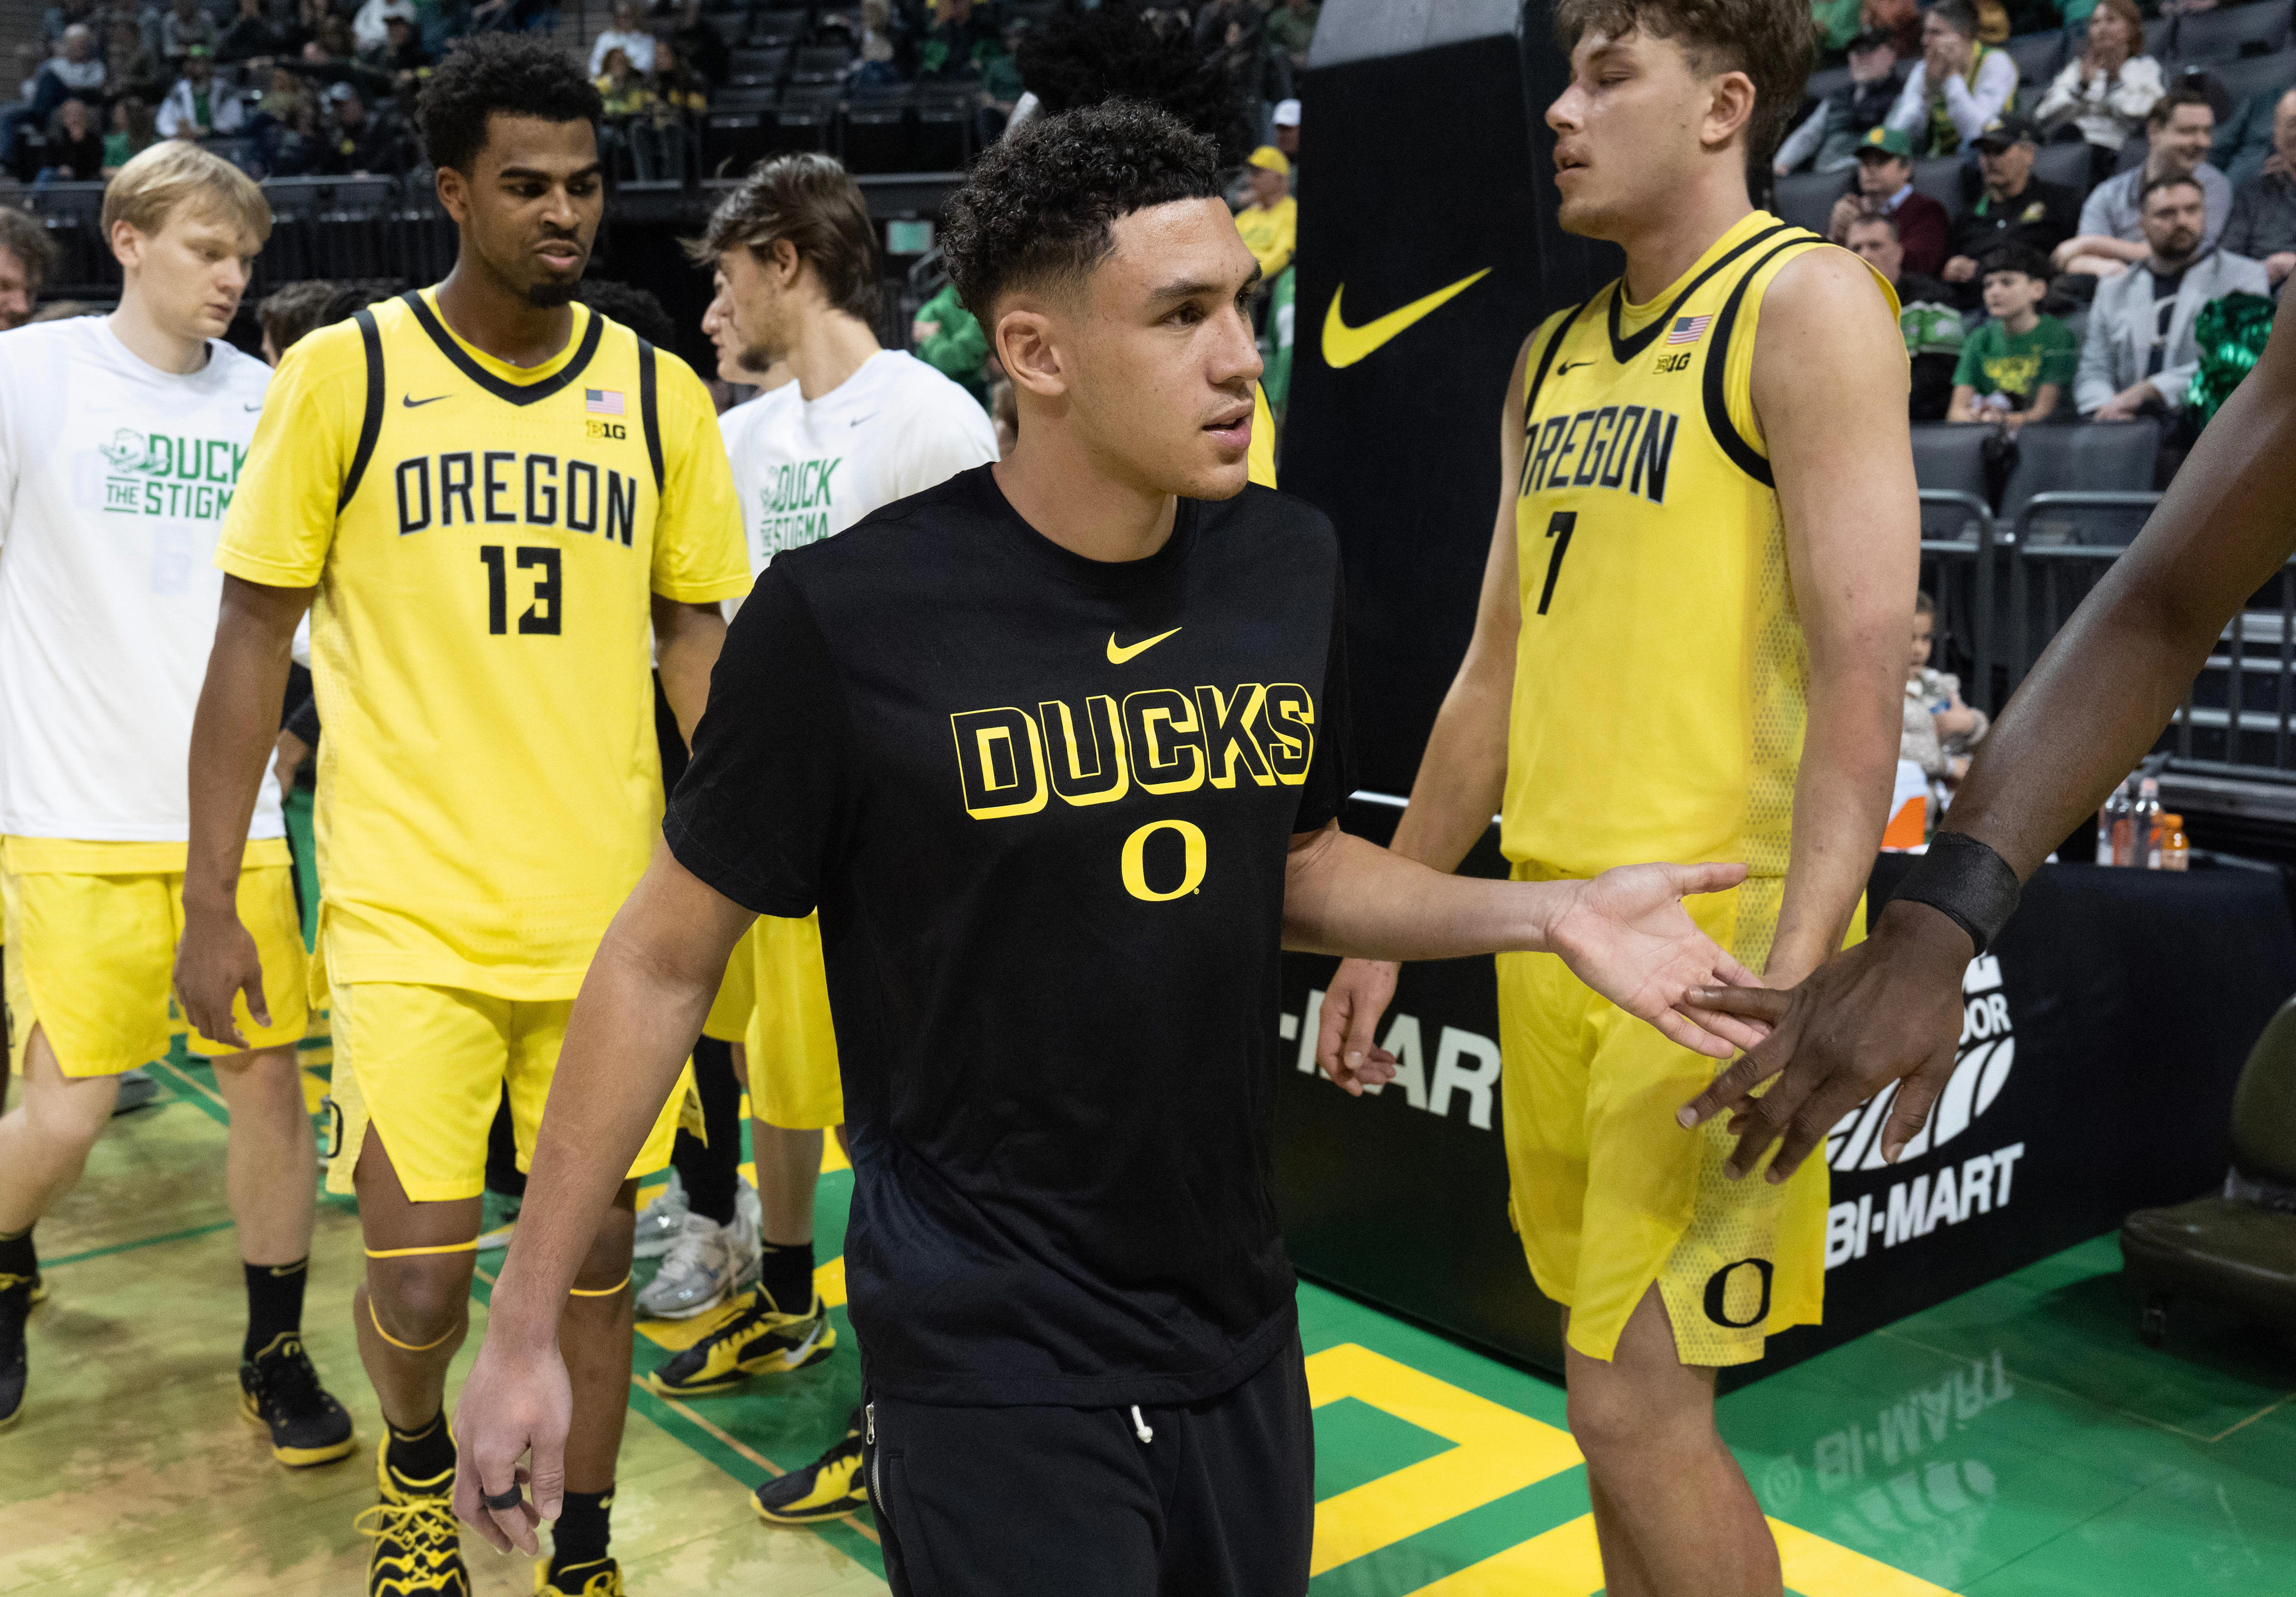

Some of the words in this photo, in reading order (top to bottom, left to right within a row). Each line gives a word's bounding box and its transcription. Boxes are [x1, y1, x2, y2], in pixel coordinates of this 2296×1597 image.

[106, 483, 139, 505] THE
[145, 481, 235, 520] STIGM
[149, 434, 249, 484] DUCK
[394, 450, 637, 549] OREGON
[776, 458, 842, 512] DUCK
[480, 545, 561, 635] 13
[1537, 512, 1577, 615] 7
[950, 682, 1314, 821] DUCKS
[1121, 819, 1207, 902] O
[1824, 1142, 2026, 1271] BI-MART
[1703, 1258, 1774, 1328] O
